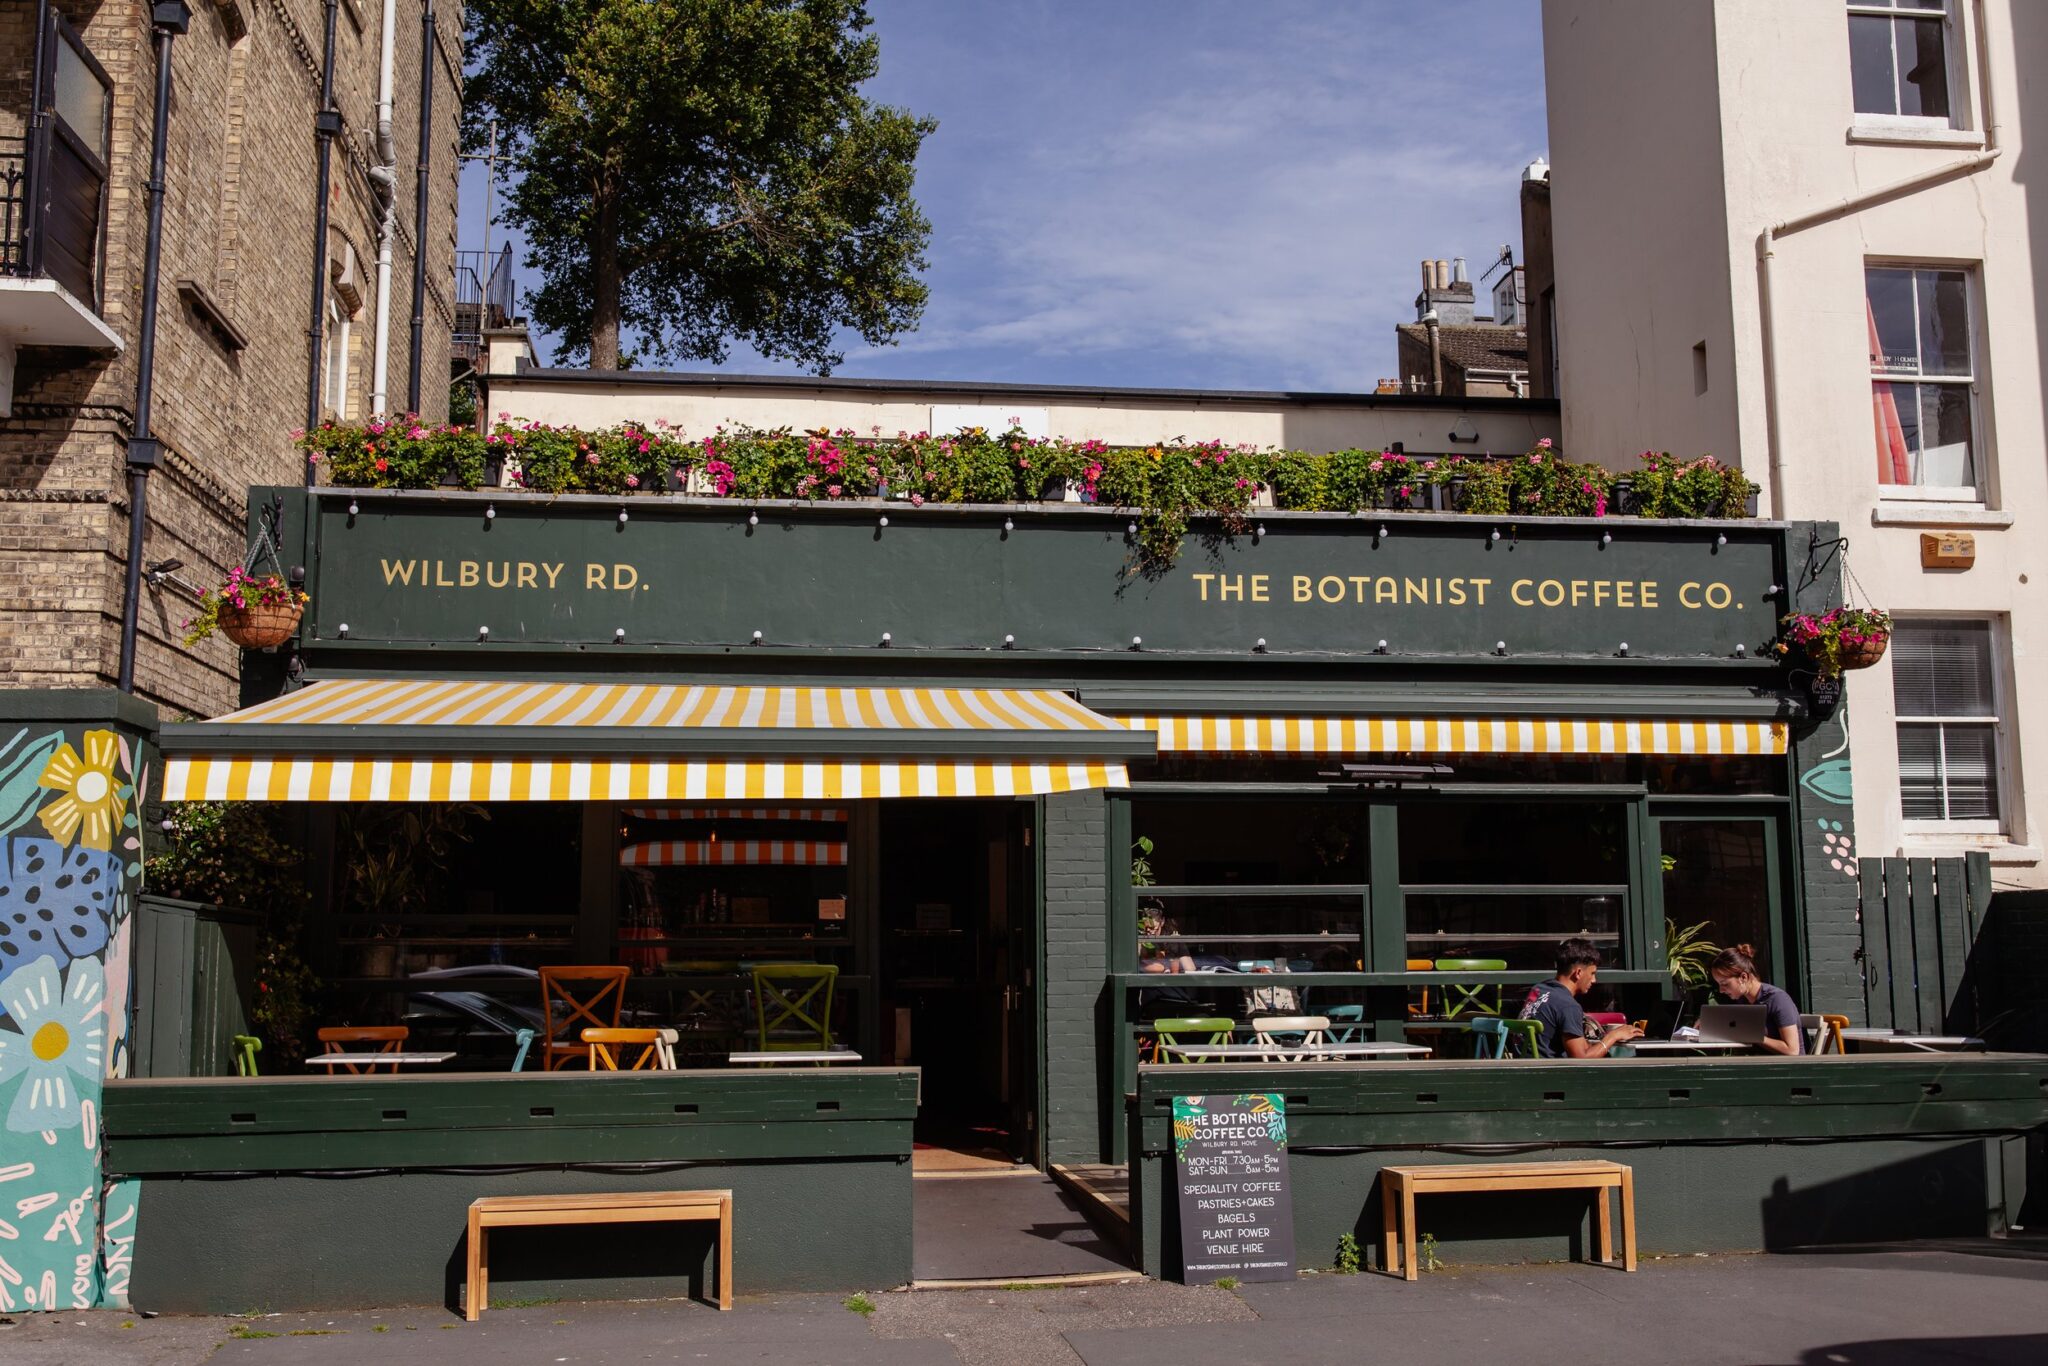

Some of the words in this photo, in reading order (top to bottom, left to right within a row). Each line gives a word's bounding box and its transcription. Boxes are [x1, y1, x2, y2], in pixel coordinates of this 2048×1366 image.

[380, 558, 565, 589] WILBURY
[586, 563, 650, 591] RD.
[1192, 574, 1270, 602] THE
[1292, 575, 1492, 606] BOTANIST
[1510, 579, 1659, 608] COFFEE
[1678, 582, 1744, 610] CO.
[1183, 1114, 1209, 1126] THE
[1212, 1111, 1276, 1125] BOTANIST
[1193, 1127, 1246, 1140] COFFEE
[1247, 1126, 1269, 1138] CO.
[1184, 1183, 1238, 1195] SPECIALITY
[1242, 1181, 1282, 1192] COFFEE
[1217, 1213, 1256, 1224] BAGELS
[1202, 1228, 1233, 1240] PLANT
[1238, 1227, 1270, 1238] POWER
[1206, 1243, 1239, 1255] VENUE
[1242, 1242, 1264, 1253] HIRE
